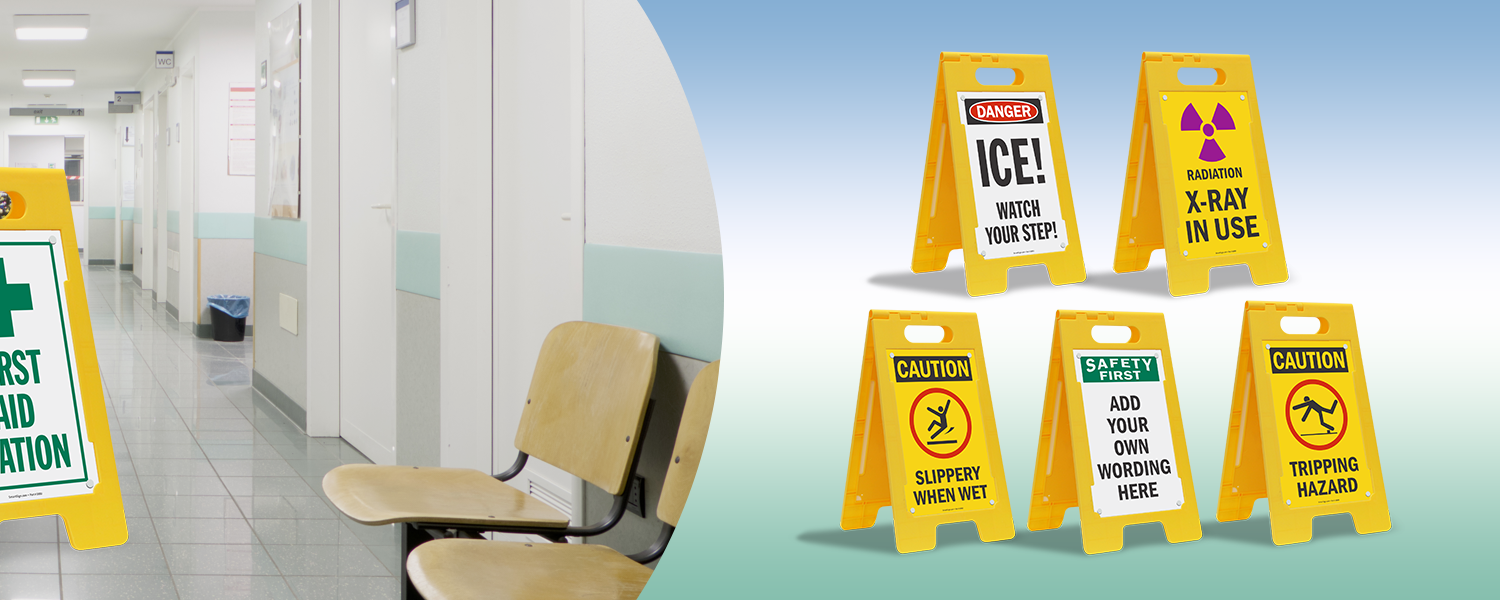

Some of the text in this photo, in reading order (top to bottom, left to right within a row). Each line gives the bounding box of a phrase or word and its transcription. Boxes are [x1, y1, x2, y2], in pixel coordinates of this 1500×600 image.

[157, 58, 172, 66] WC
[976, 105, 1031, 118] DANGER
[976, 138, 1046, 187] ICE!
[1187, 167, 1243, 181] RADIATION
[996, 199, 1041, 220] WATCH
[1185, 187, 1248, 214] X-RAY
[985, 221, 1058, 245] YOUR STEP!
[1185, 215, 1260, 243] IN USE
[897, 360, 969, 378] CAUTION
[1086, 358, 1152, 372] SAFETY
[1273, 351, 1345, 369] CAUTION
[1099, 370, 1141, 381] FIRST
[1110, 395, 1141, 411] ADD
[1106, 417, 1149, 434] YOUR
[1114, 438, 1149, 456] OWN
[915, 466, 980, 485] SLIPPERY
[1097, 459, 1171, 480] WORDING
[1289, 456, 1359, 477] TRIPPING
[913, 484, 987, 505] WHEN WET
[1118, 482, 1159, 500] HERE
[1297, 477, 1358, 497] HAZARD
